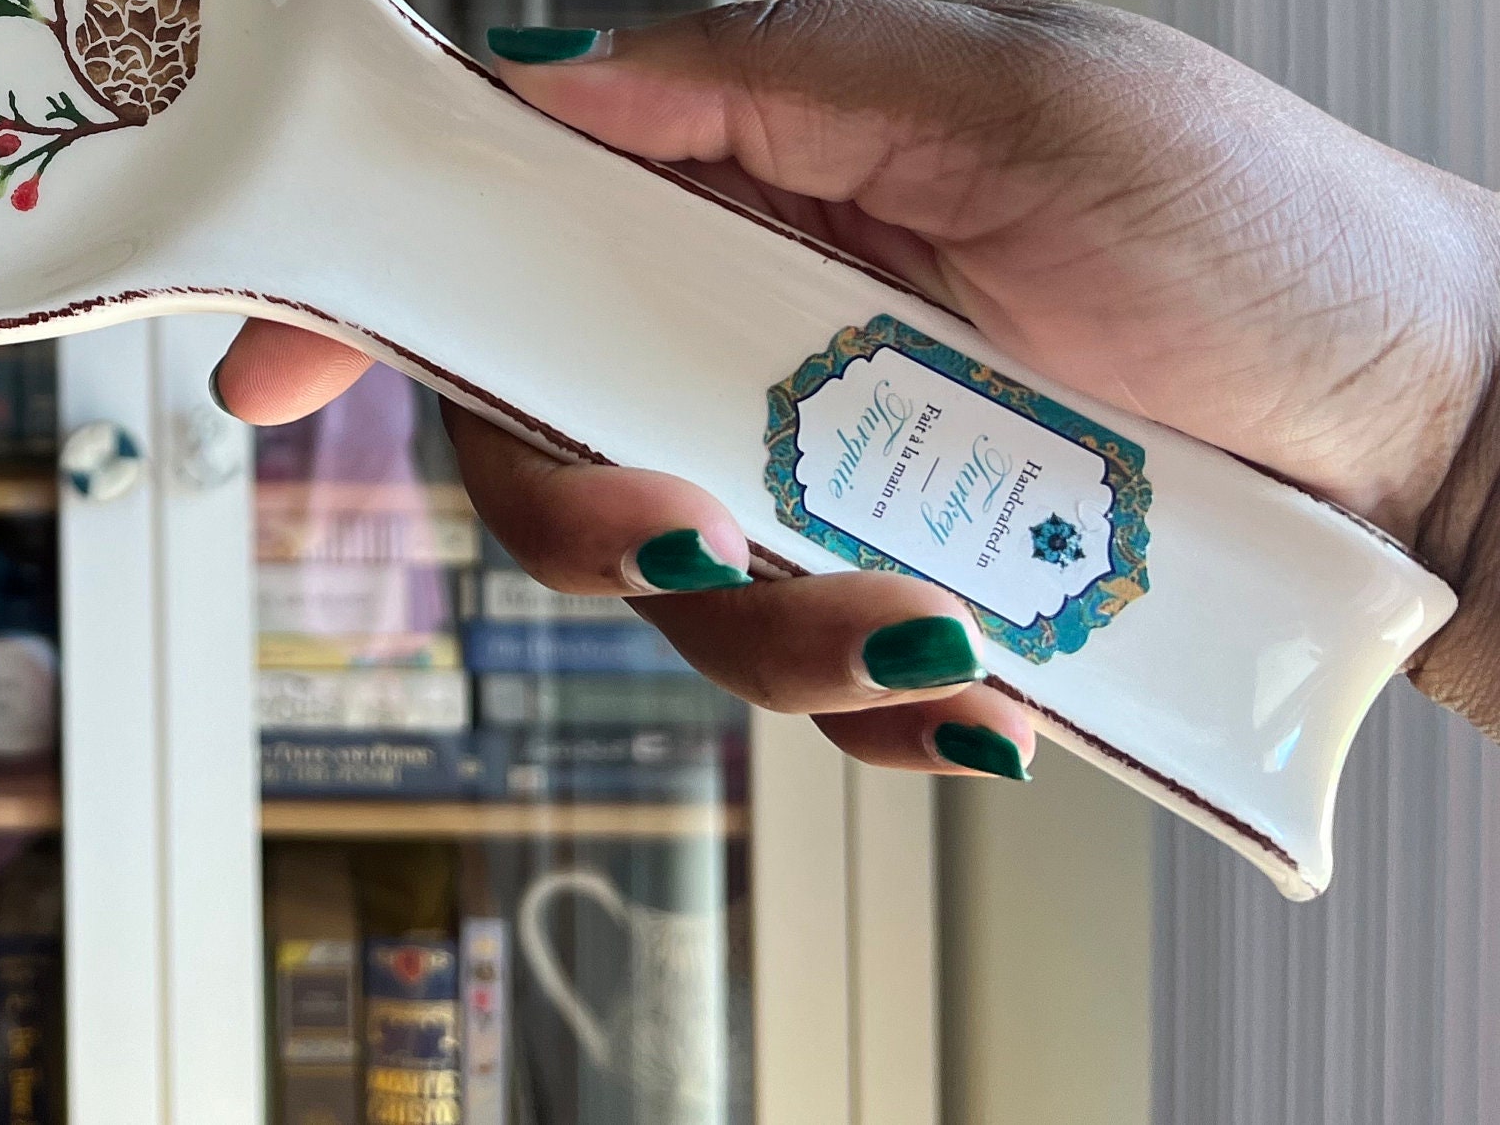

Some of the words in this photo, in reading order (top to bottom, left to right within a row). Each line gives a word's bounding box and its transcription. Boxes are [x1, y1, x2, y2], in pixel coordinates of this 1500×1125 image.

[914, 402, 943, 434] Fait
[827, 379, 914, 500] Turquie
[900, 446, 920, 460] la
[908, 434, 925, 445] à
[881, 461, 907, 499] main
[919, 434, 1013, 547] Turkey
[871, 500, 888, 519] en
[984, 459, 1043, 554] Handcrafted
[975, 553, 996, 568] in
